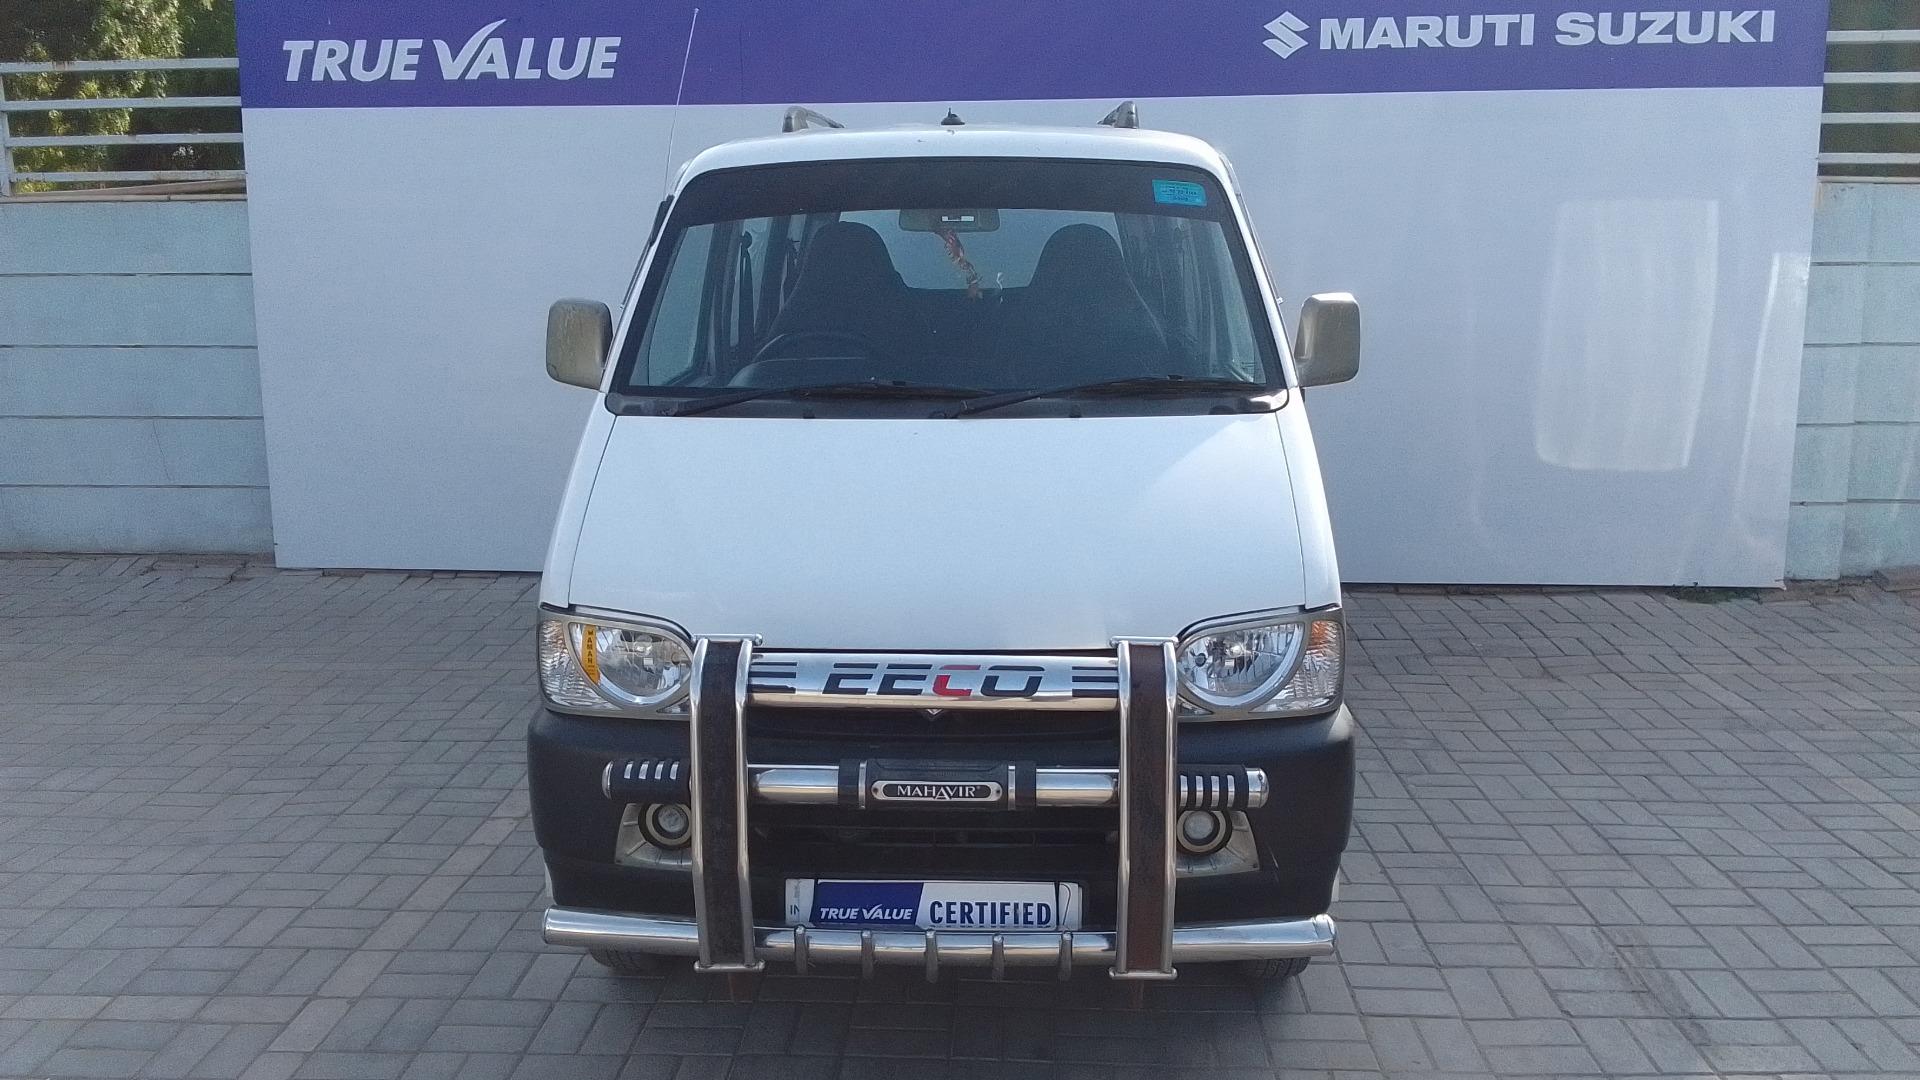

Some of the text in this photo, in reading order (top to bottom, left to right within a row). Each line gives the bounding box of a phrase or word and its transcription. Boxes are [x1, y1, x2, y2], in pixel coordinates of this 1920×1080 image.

[1319, 10, 1775, 50] MARUTI SUZUKI
[282, 18, 621, 82] TRUE VALUE
[822, 663, 1045, 697] EECO
[896, 785, 978, 801] MAHAVIR
[820, 903, 913, 921] TRUE VALUE
[929, 900, 1052, 926] CERTIFIED
